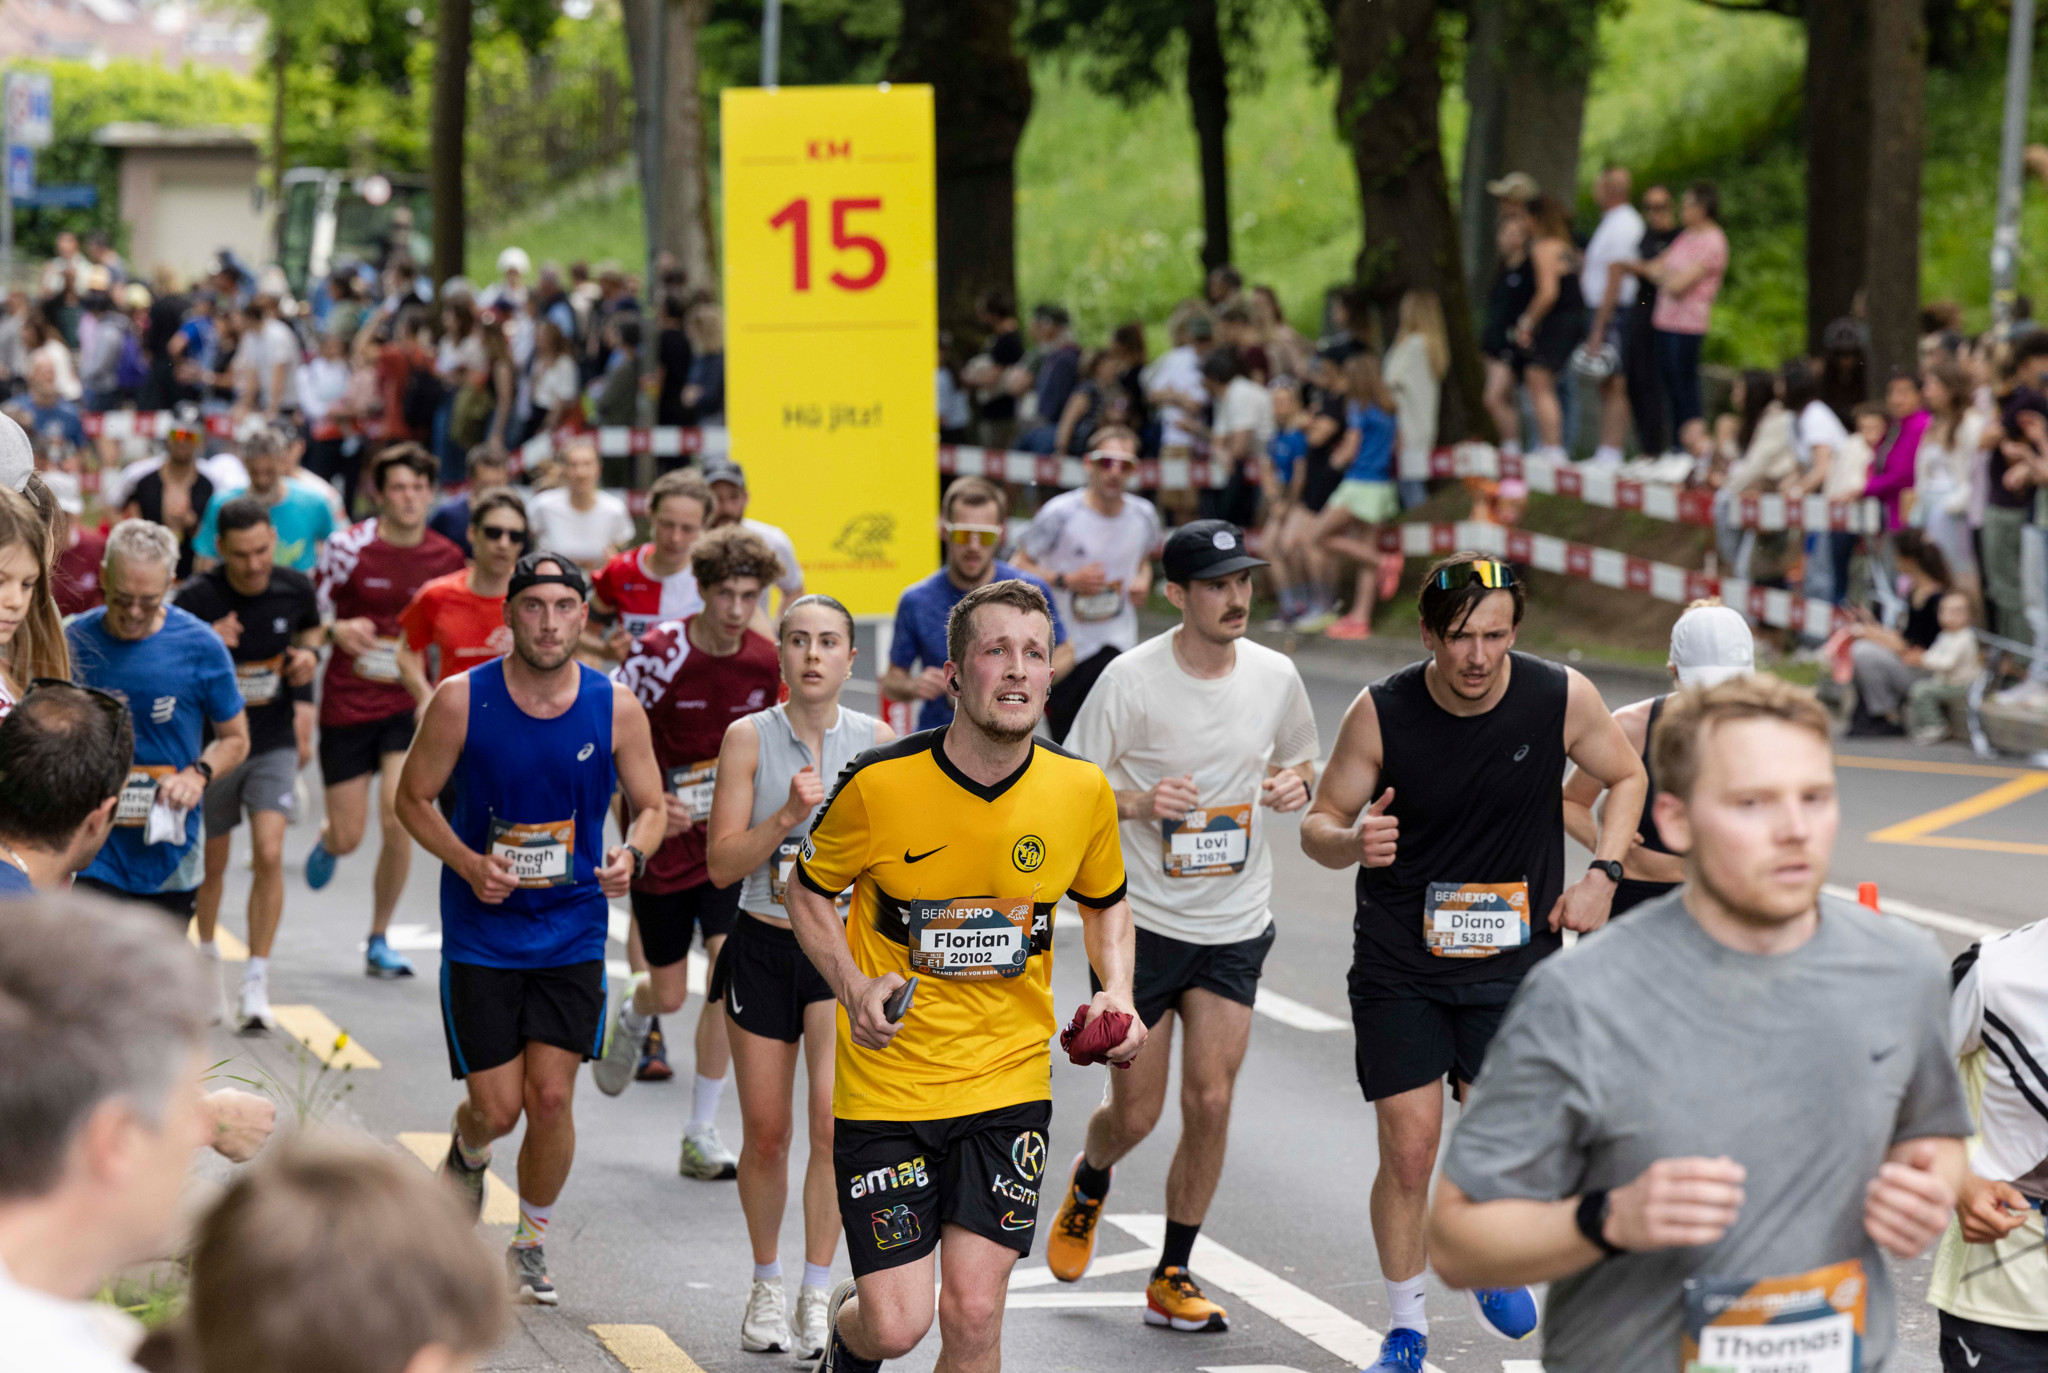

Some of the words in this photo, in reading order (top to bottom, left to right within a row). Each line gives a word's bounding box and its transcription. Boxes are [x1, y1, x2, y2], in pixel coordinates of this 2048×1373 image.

[805, 138, 851, 160] KM
[769, 197, 888, 293] 15
[1196, 833, 1228, 850] Levi
[505, 849, 553, 865] Gregh
[1196, 851, 1228, 863] 21676
[1434, 891, 1498, 903] BERNEXPO
[921, 907, 993, 920] BERNEXPO
[1451, 913, 1505, 929] Diano
[934, 931, 1009, 948] Florian
[1461, 933, 1494, 944] 5338
[927, 958, 940, 968] E1
[950, 952, 992, 964] 20102
[850, 1155, 929, 1199] amag
[992, 1174, 1040, 1207] Kom
[1711, 1329, 1841, 1358] Thomas
